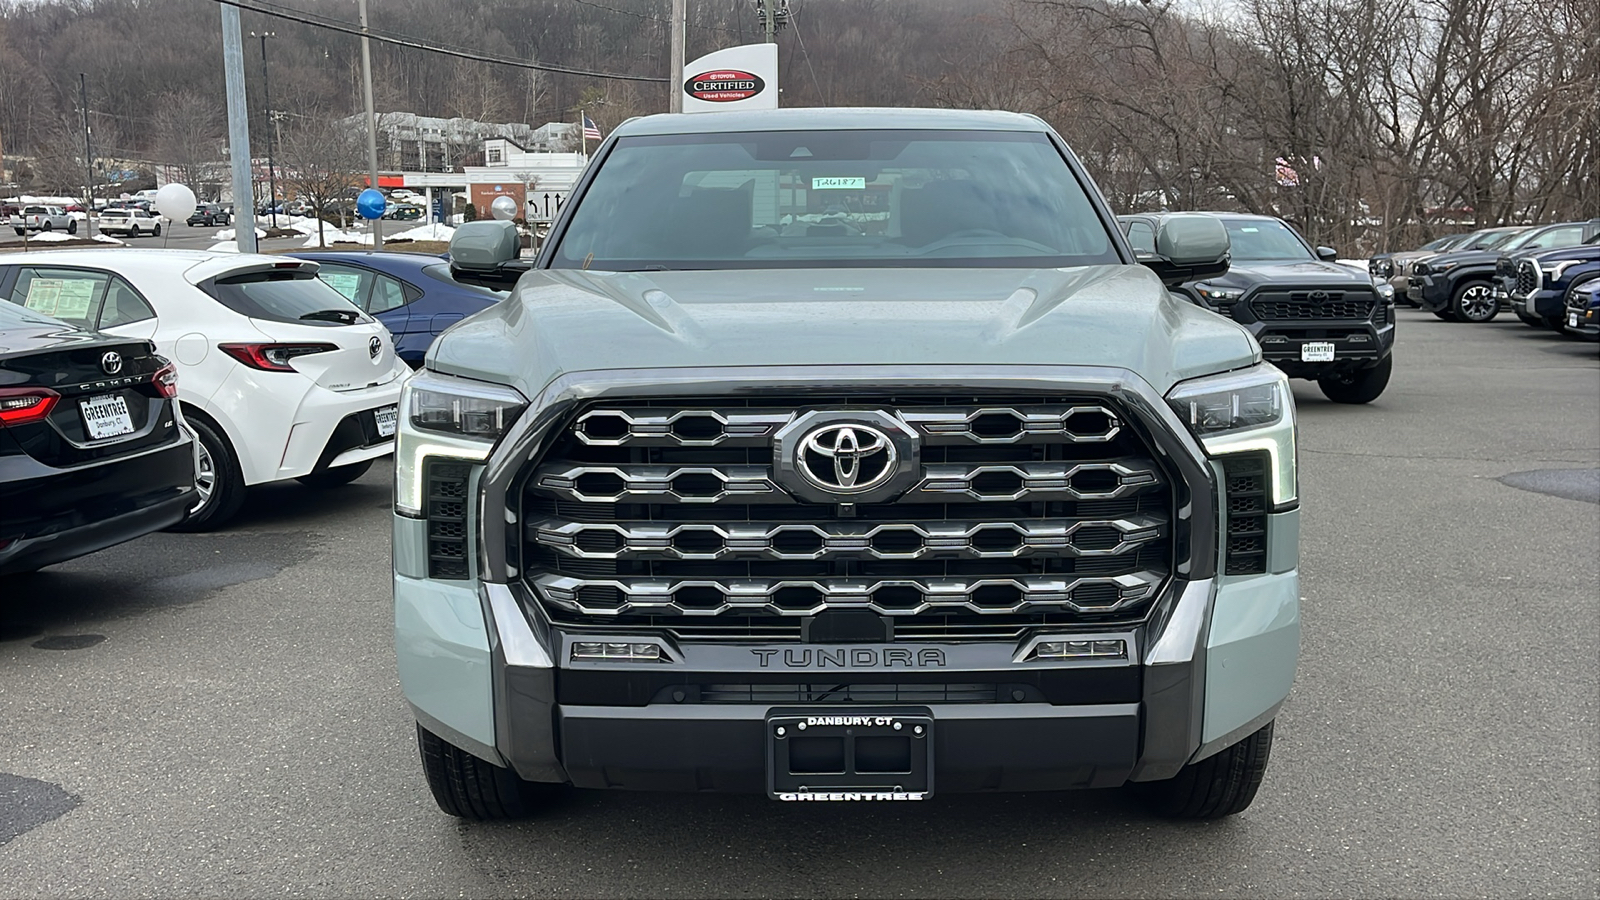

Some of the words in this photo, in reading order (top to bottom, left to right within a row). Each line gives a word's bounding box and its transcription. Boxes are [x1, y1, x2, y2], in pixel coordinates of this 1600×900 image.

[693, 81, 755, 91] CERTIFIED
[80, 376, 142, 390] CAMRY
[84, 401, 127, 421] GREENTREE
[750, 649, 946, 668] TUNDRA
[807, 717, 872, 726] DANBURY,
[875, 717, 893, 726] CT
[779, 792, 923, 801] GREENTREE
